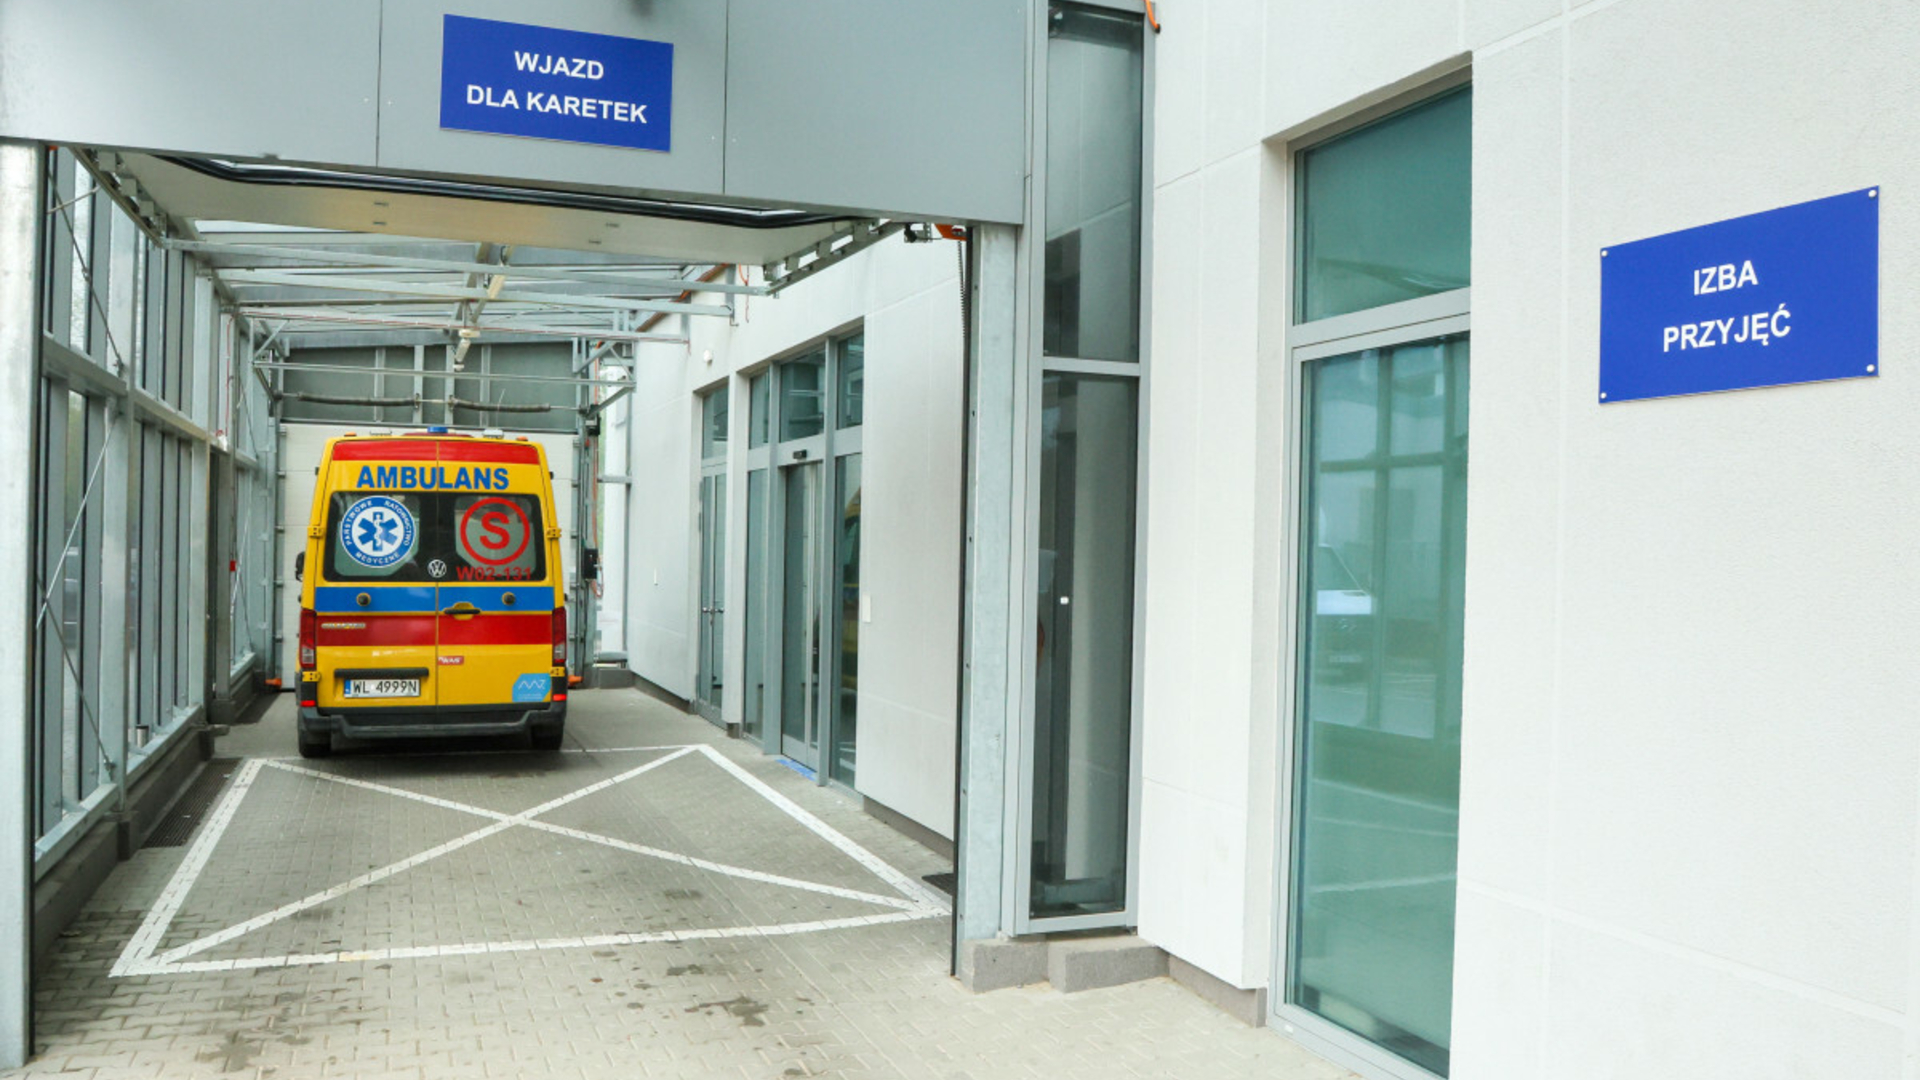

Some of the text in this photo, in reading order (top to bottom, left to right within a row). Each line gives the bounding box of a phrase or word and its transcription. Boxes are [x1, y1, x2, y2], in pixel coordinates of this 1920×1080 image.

[514, 51, 604, 80] WJAZD
[466, 84, 648, 123] DLA KARETEK
[1693, 260, 1759, 296] IZBA
[1663, 303, 1791, 352] PRZYJĘĆ
[356, 465, 509, 490] AMBULANS
[479, 511, 510, 550] S
[456, 566, 532, 581] W02-131
[353, 680, 417, 694] WL 4999N
